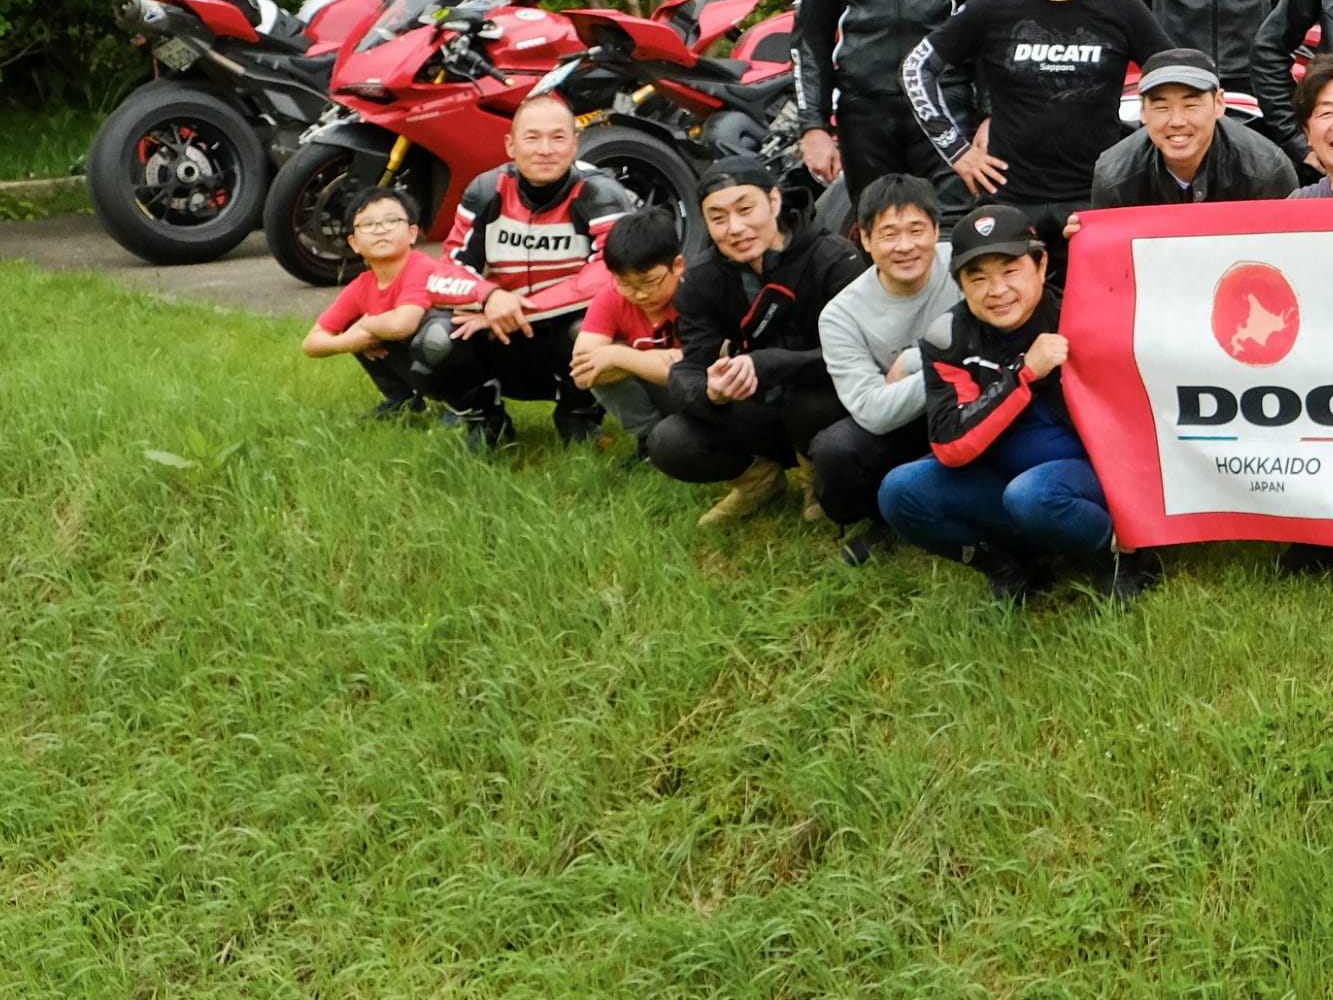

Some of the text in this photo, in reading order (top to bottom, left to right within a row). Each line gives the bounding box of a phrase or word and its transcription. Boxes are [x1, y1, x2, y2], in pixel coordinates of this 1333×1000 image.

[1014, 43, 1102, 63] DUCATI
[1039, 62, 1076, 72] Sapporo
[498, 229, 572, 251] DUCATI
[1215, 456, 1321, 476] HOKKAIDO
[1249, 481, 1285, 493] JAPAN
